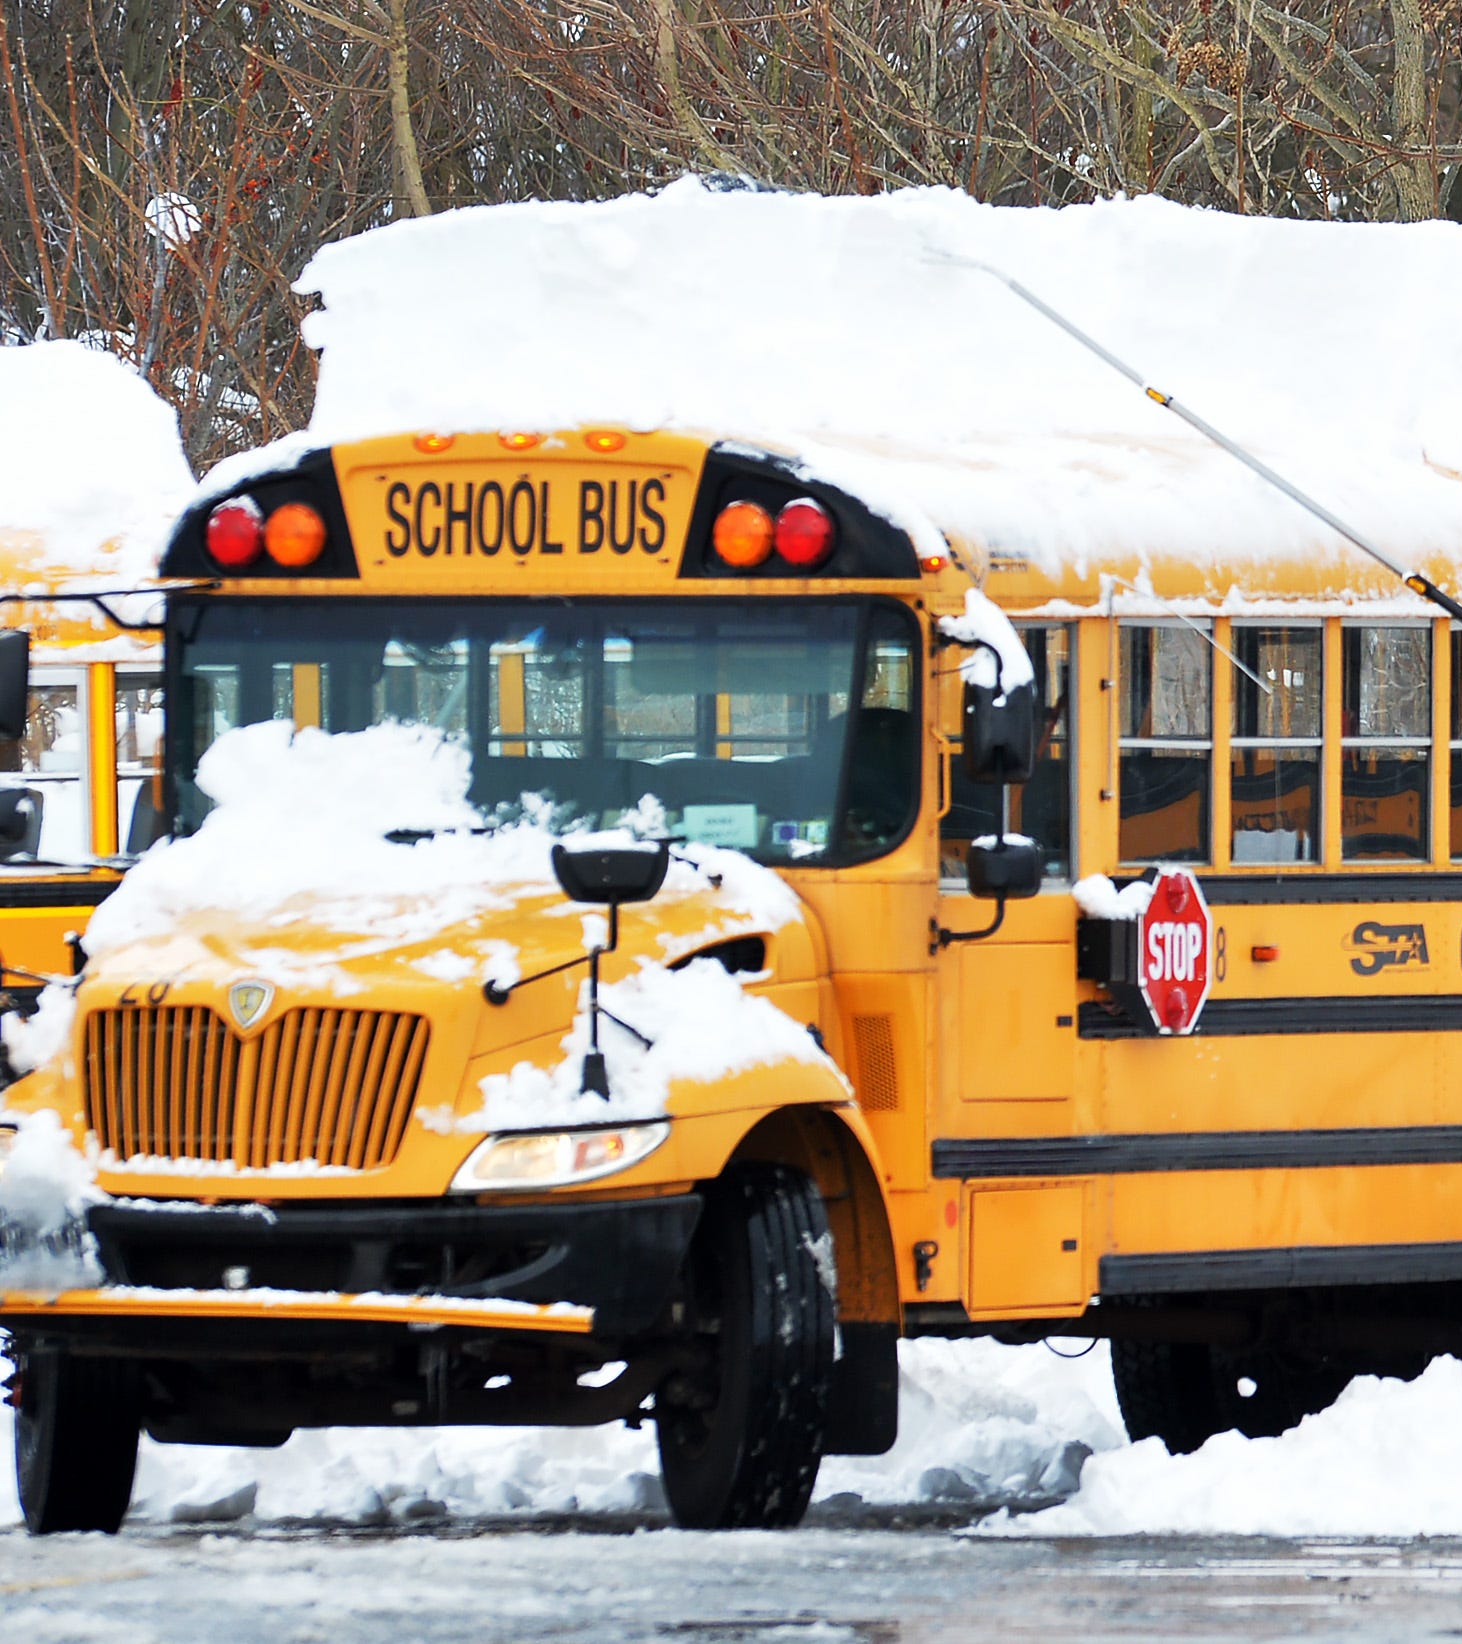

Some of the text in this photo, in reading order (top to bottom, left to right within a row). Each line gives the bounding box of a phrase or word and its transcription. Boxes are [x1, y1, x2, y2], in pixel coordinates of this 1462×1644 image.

[385, 478, 666, 557] SCHOOL BUS
[1148, 922, 1202, 981] STOP
